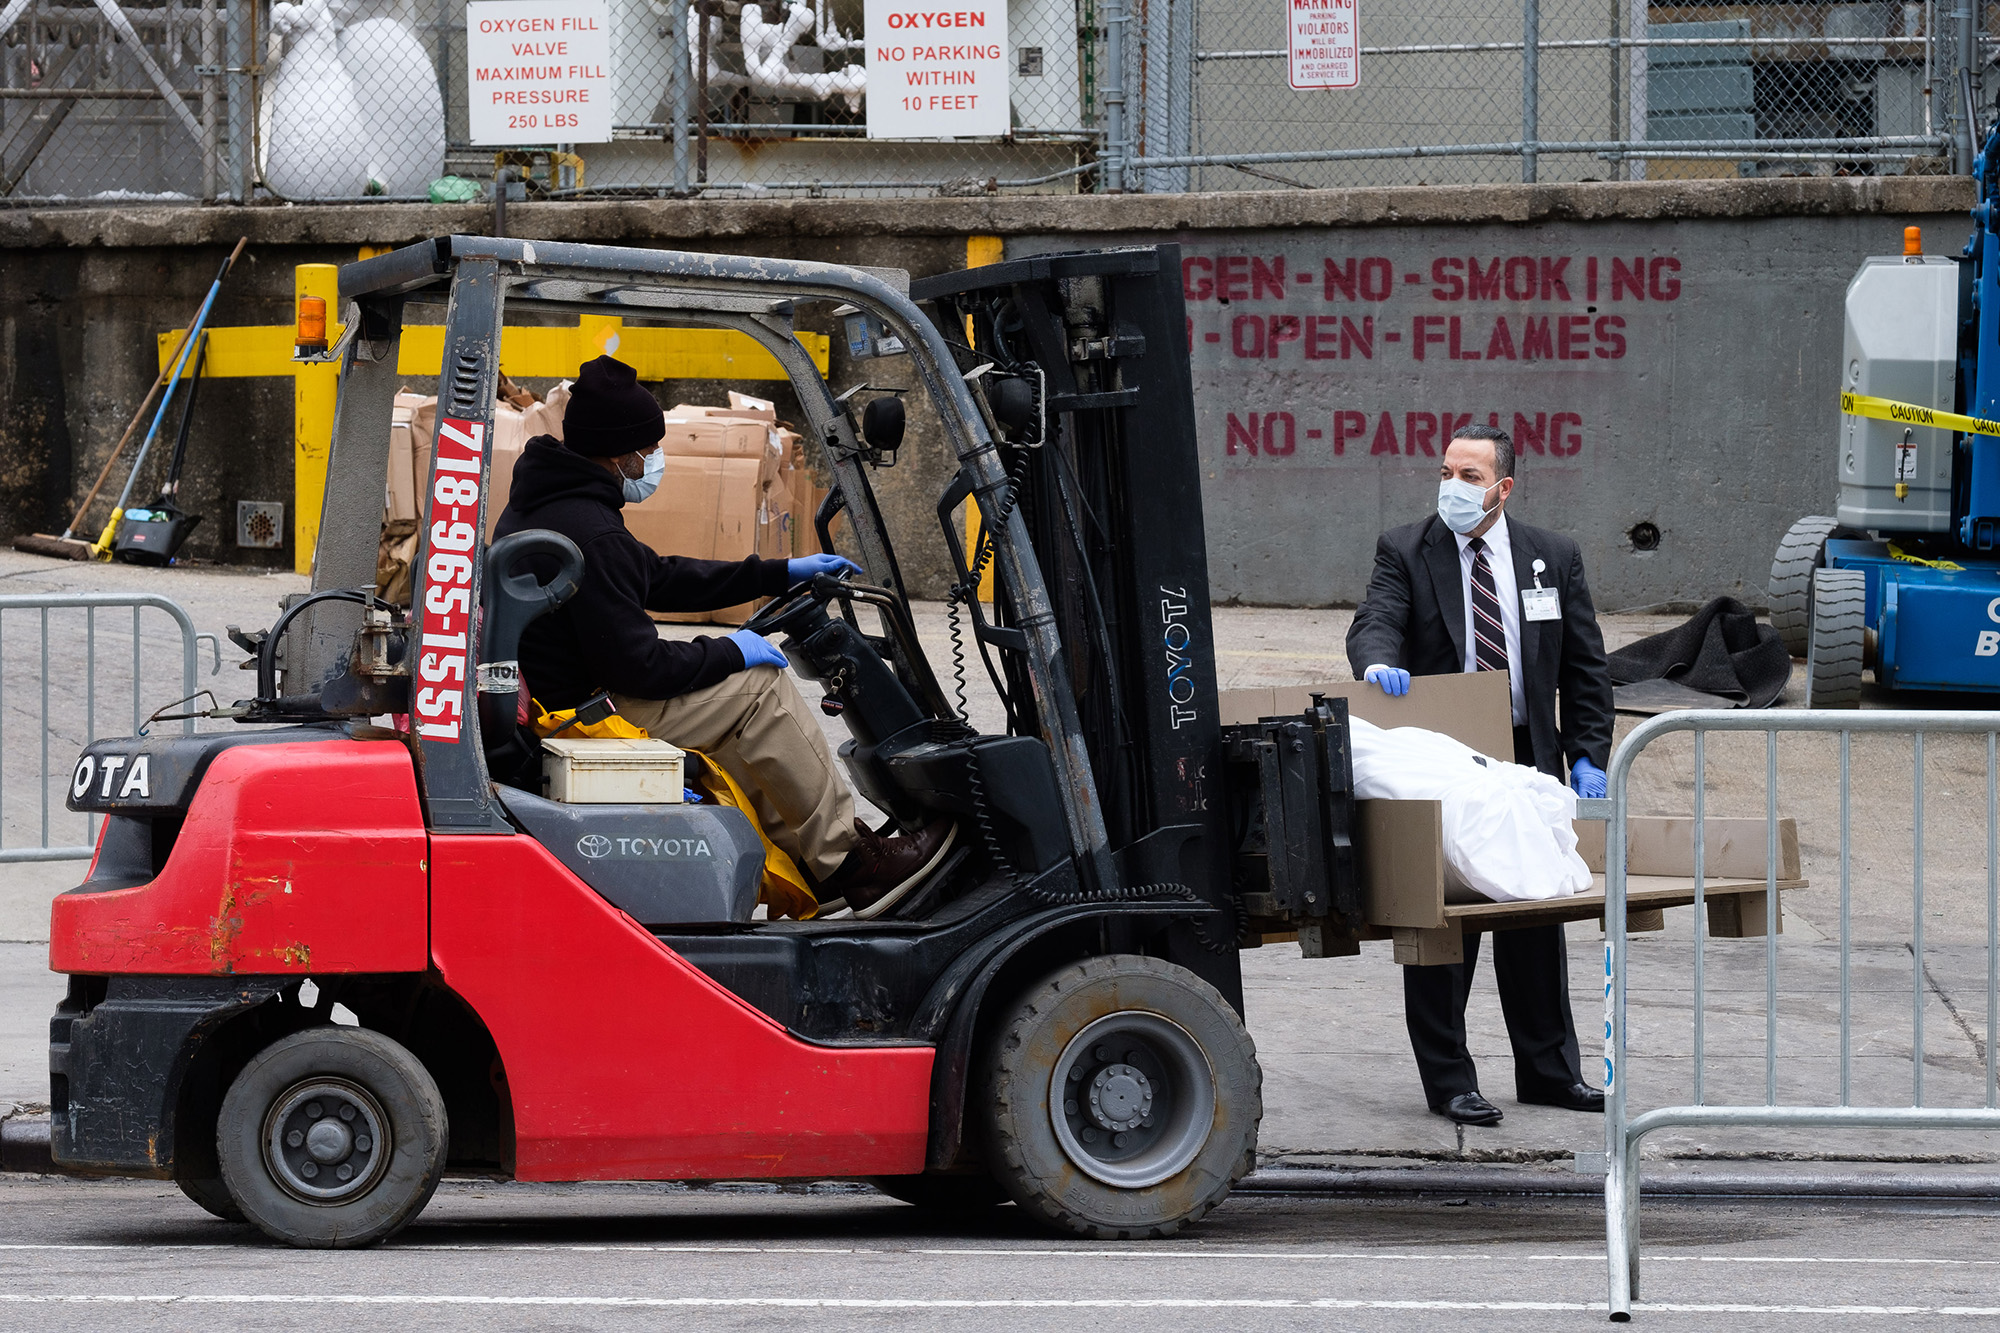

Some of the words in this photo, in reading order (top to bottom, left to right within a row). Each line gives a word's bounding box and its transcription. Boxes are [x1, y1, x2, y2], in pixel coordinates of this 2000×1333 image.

[1294, 0, 1352, 10] WARNING
[887, 11, 985, 29] OXYGEN
[1310, 12, 1337, 20] PARKING
[480, 18, 555, 33] OXYGEN
[562, 17, 599, 31] FILL
[1297, 21, 1349, 35] VIOLATORS
[512, 42, 568, 56] VALVE
[1327, 37, 1336, 45] BE
[878, 47, 905, 62] NO
[913, 45, 1000, 61] PARKING
[1294, 47, 1353, 60] IMMOBILIZED
[476, 66, 562, 81] MAXIMUM
[569, 65, 606, 79] FILL
[1317, 62, 1348, 70] CHARGED
[906, 70, 975, 86] WITHIN
[1307, 71, 1335, 79] SERVICE
[493, 89, 590, 105] PRESSURE
[902, 96, 922, 111] 10
[930, 95, 979, 110] FEET
[508, 115, 538, 129] 250
[544, 114, 579, 128] LBS
[1890, 404, 1934, 424] CAUTION
[416, 422, 485, 739] 718-965-1551
[73, 754, 150, 798] OTA
[616, 838, 712, 857] TOYOTA
